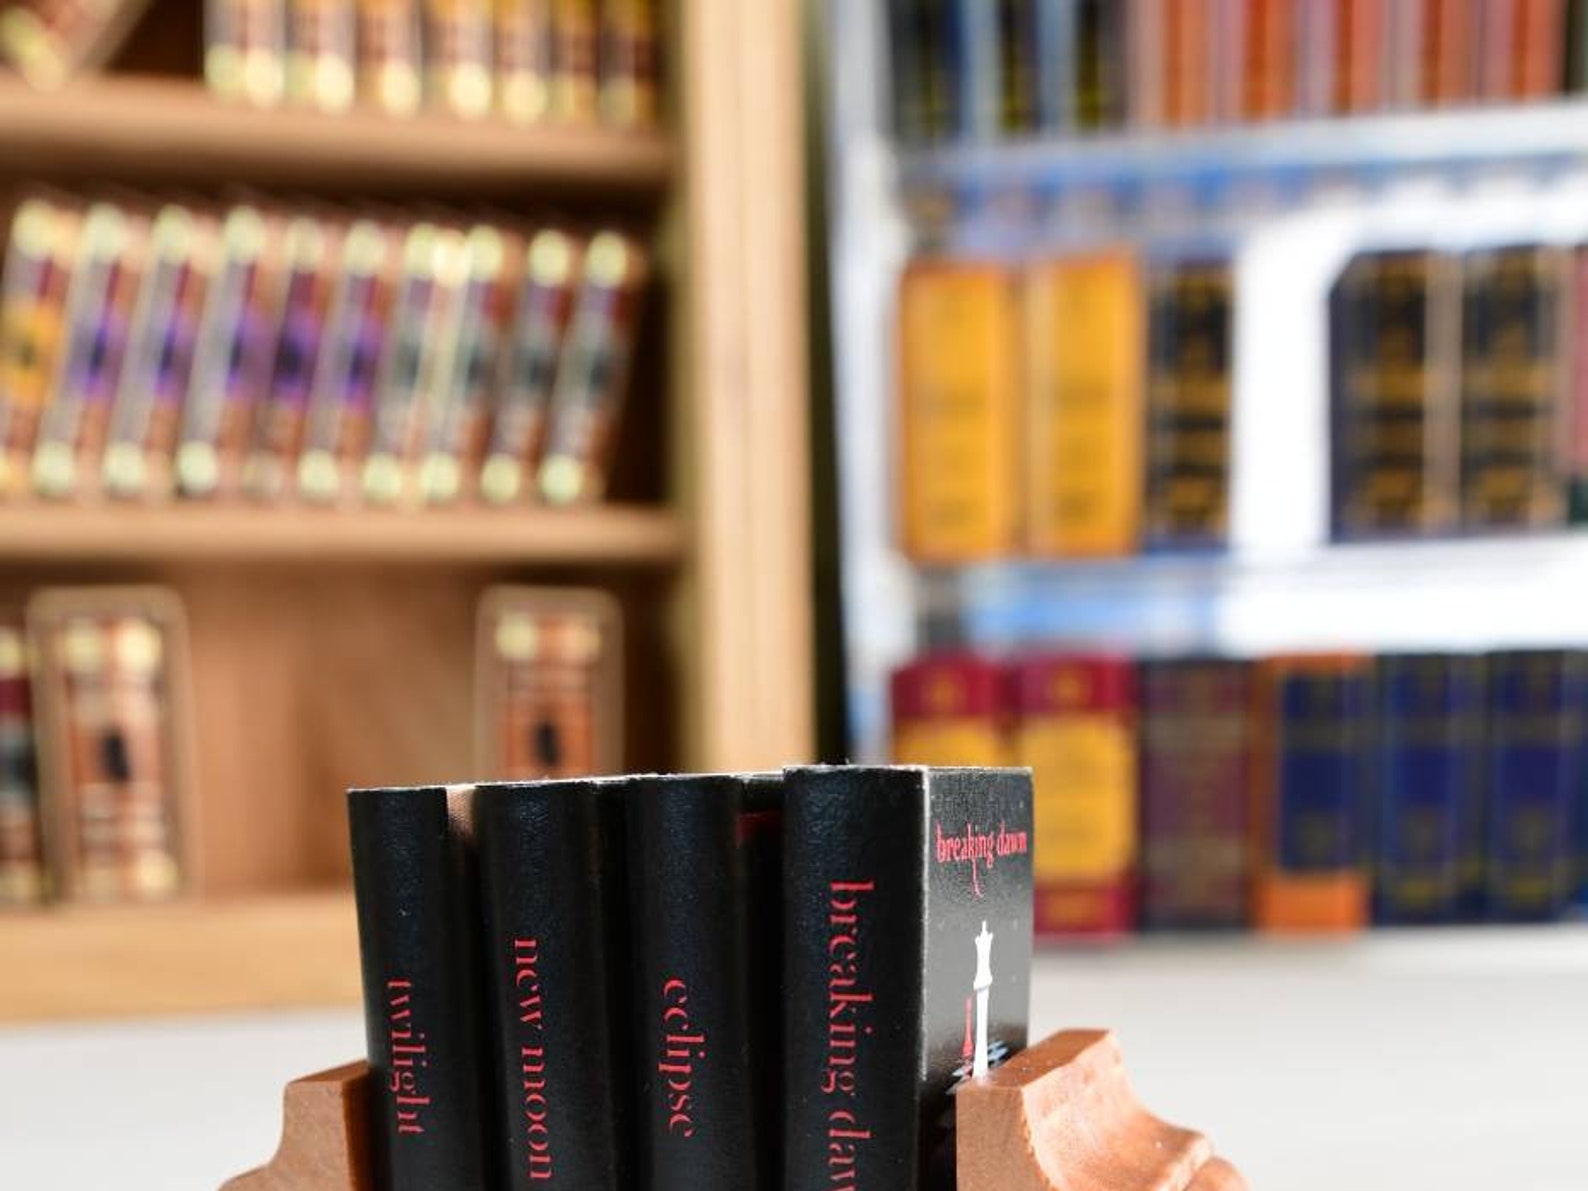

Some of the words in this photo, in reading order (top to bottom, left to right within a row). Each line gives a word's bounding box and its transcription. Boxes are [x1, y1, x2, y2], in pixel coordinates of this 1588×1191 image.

[935, 821, 995, 898] breaking
[996, 822, 1028, 856] dawn
[386, 977, 431, 1135] twilight
[513, 937, 544, 1031] new
[656, 976, 706, 1138] eclipse
[821, 880, 875, 1097] breaking
[521, 1045, 553, 1180] moon
